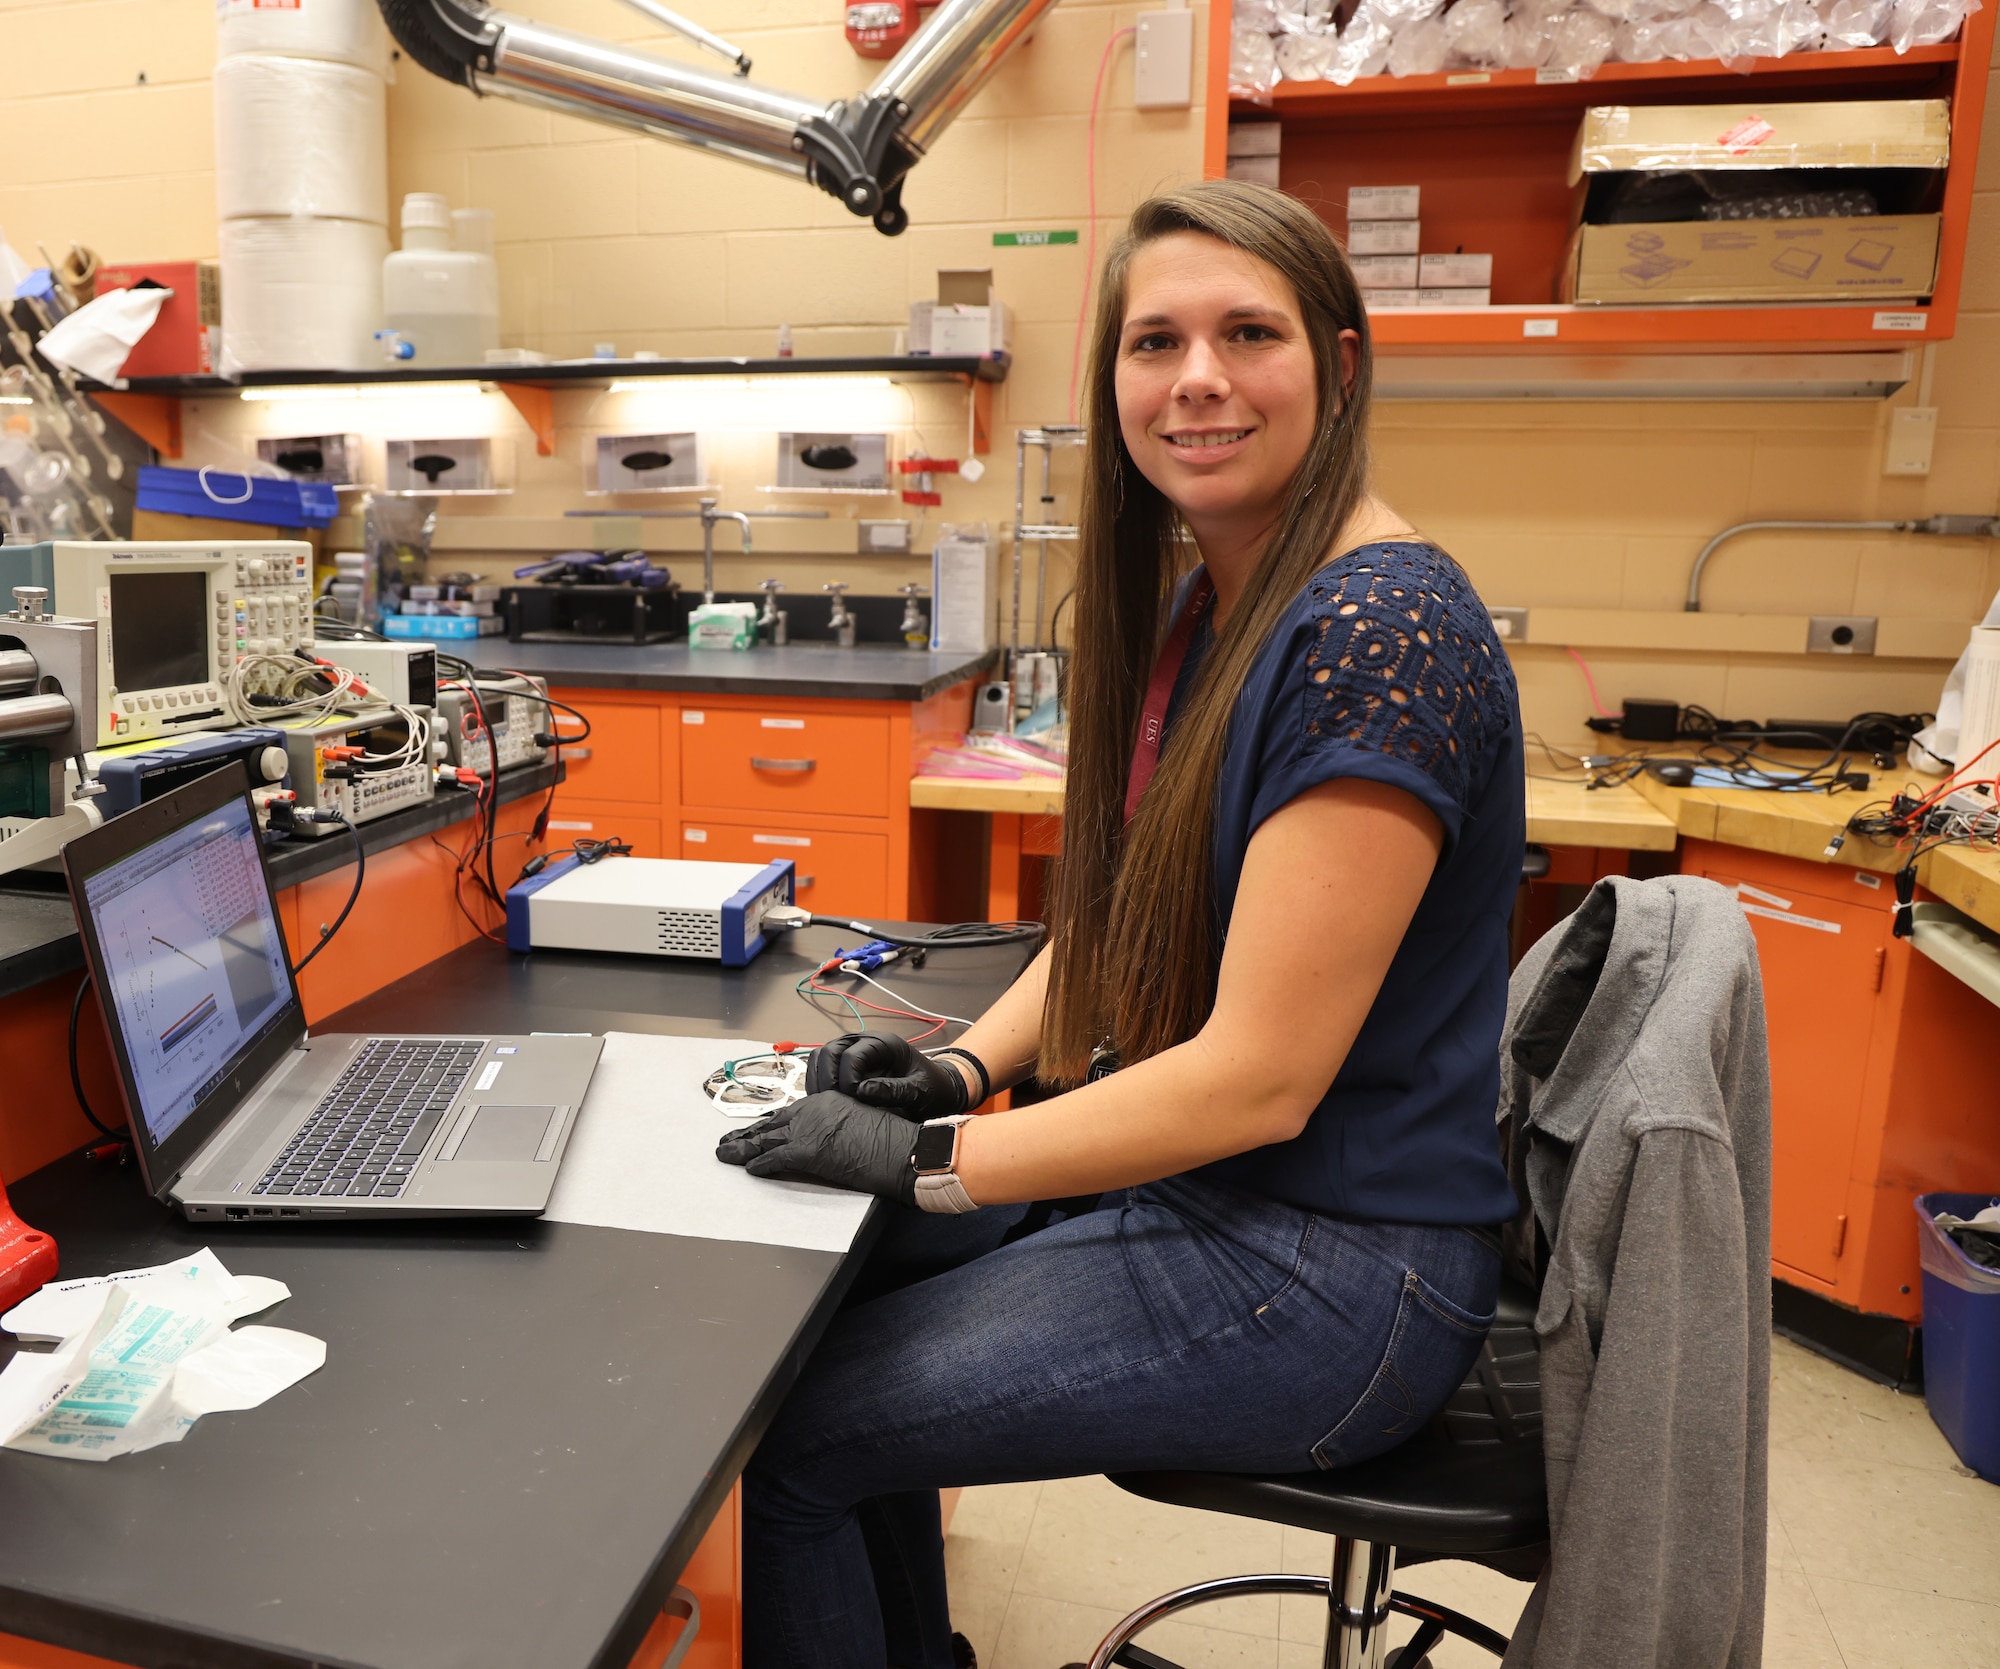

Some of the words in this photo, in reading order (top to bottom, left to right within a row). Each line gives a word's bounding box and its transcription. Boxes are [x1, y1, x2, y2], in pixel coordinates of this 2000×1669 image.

[857, 29, 887, 40] FIRE
[1015, 232, 1050, 245] VENT
[1146, 719, 1158, 743] UES
